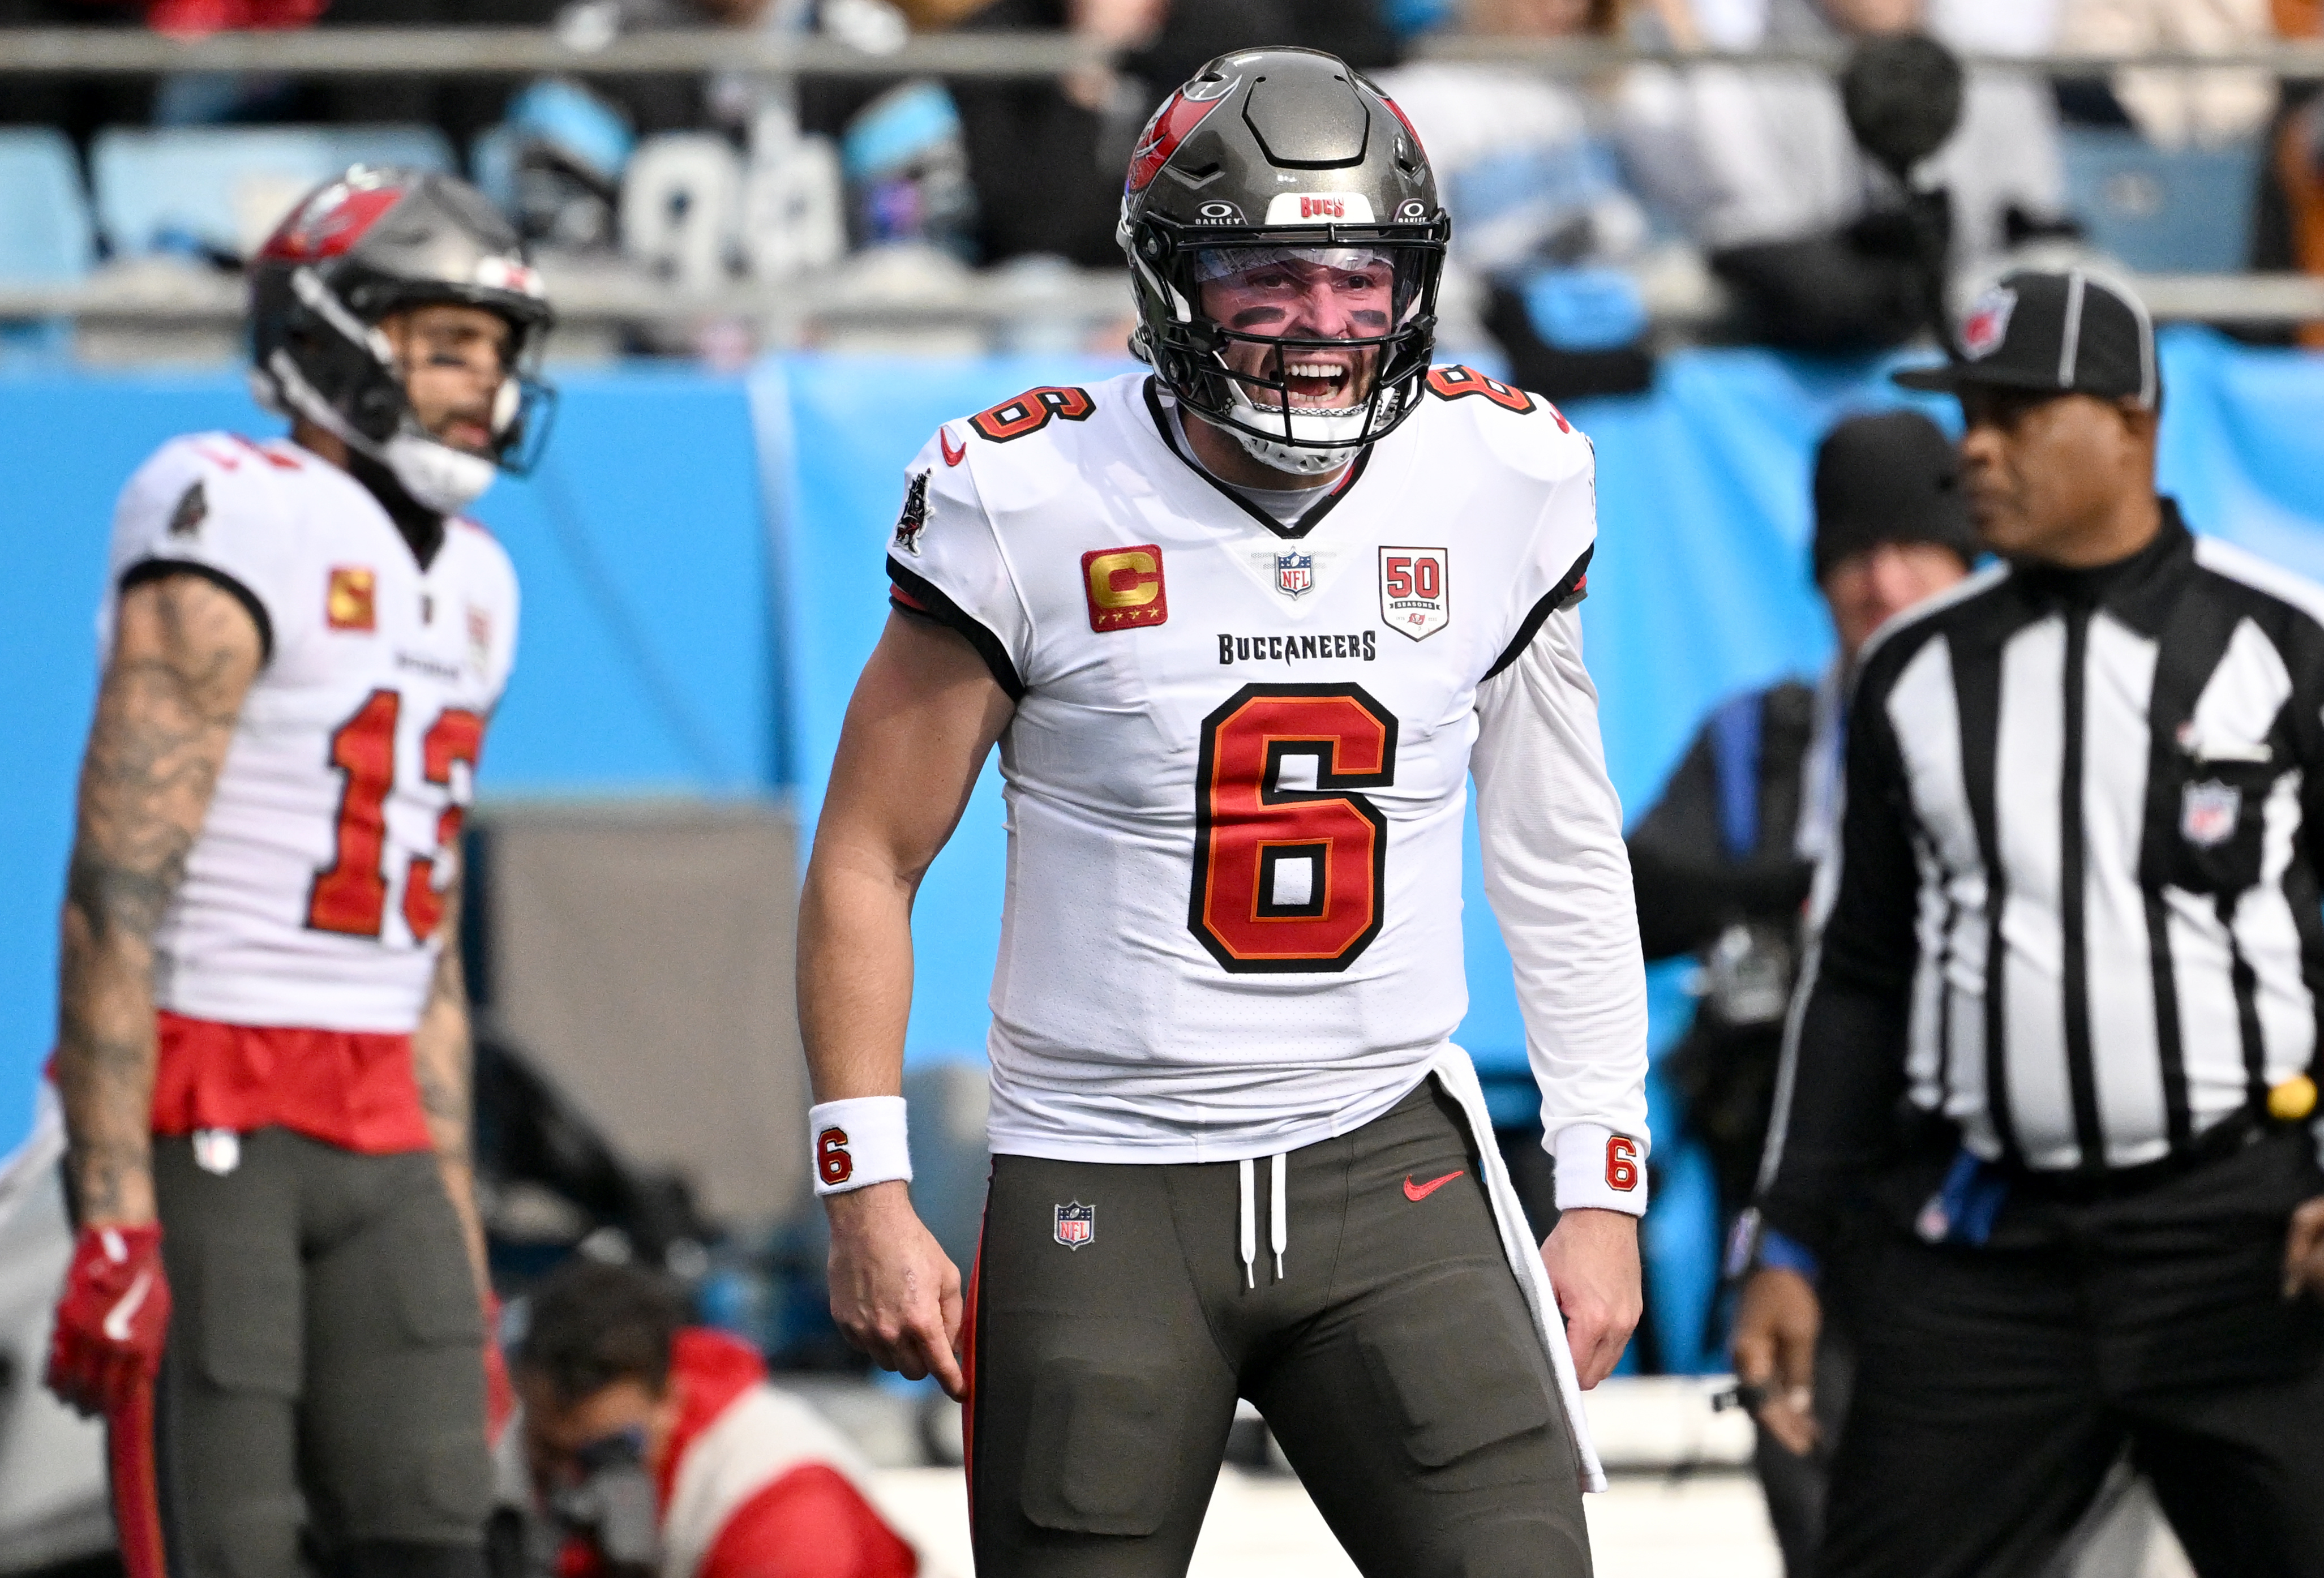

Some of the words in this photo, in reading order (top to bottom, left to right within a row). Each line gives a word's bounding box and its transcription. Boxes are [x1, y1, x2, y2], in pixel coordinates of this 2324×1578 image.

[1300, 196, 1345, 217] BUCS
[968, 386, 1096, 443] 6
[1090, 552, 1159, 608] C
[1282, 571, 1309, 590] NFL
[1387, 557, 1440, 600] 50
[1217, 630, 1376, 667] BUCCANEERS
[1187, 682, 1399, 974] 6
[816, 1126, 852, 1186] 6
[1605, 1135, 1637, 1191] 6
[1060, 1221, 1088, 1241] NFL
